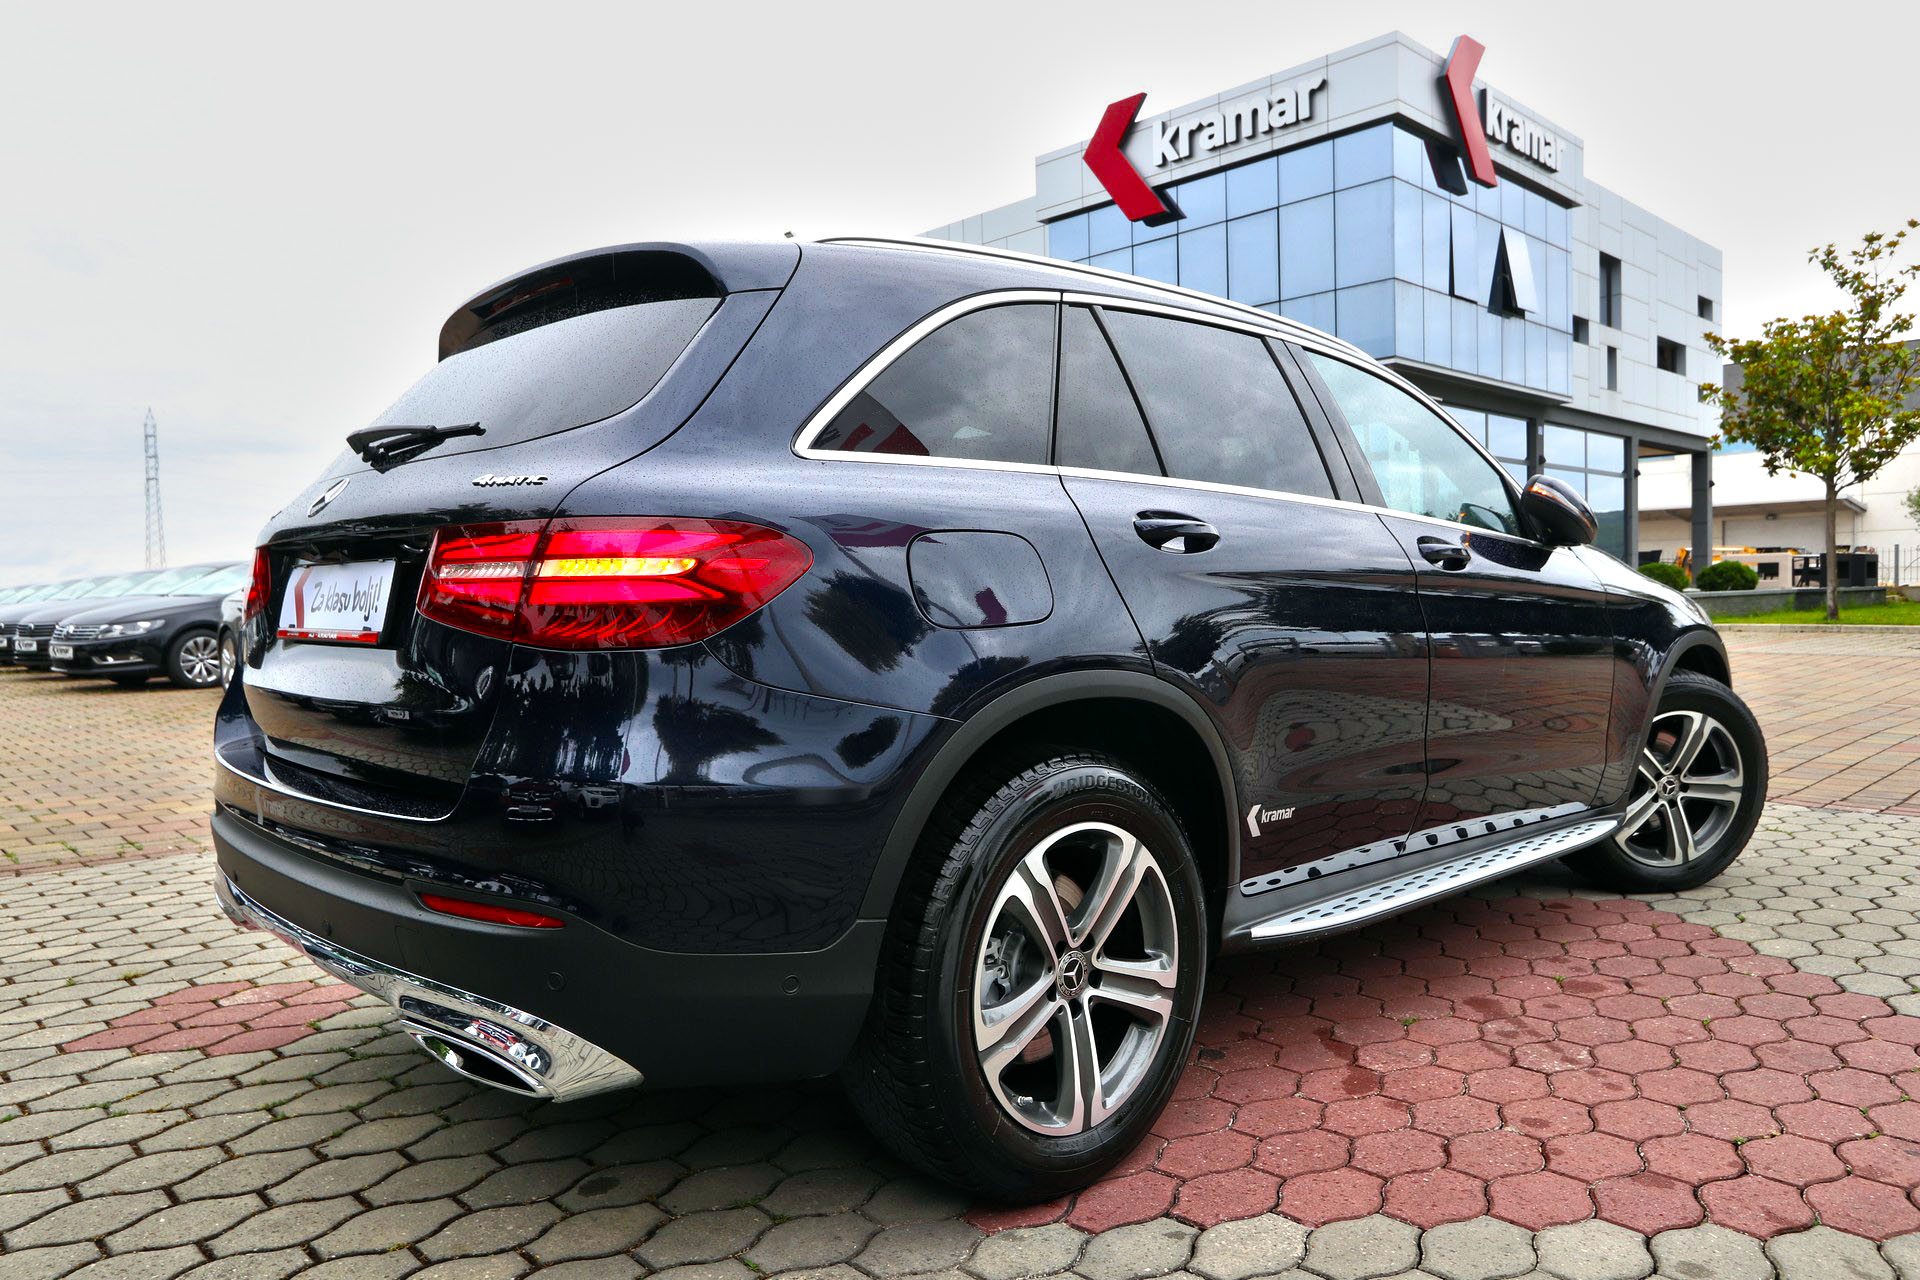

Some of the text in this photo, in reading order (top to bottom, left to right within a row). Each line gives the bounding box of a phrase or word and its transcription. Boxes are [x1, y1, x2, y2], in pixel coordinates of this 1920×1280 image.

[1152, 78, 1326, 167] kramar
[311, 576, 383, 622] Za klasu bolji!
[1261, 807, 1296, 824] kramar
